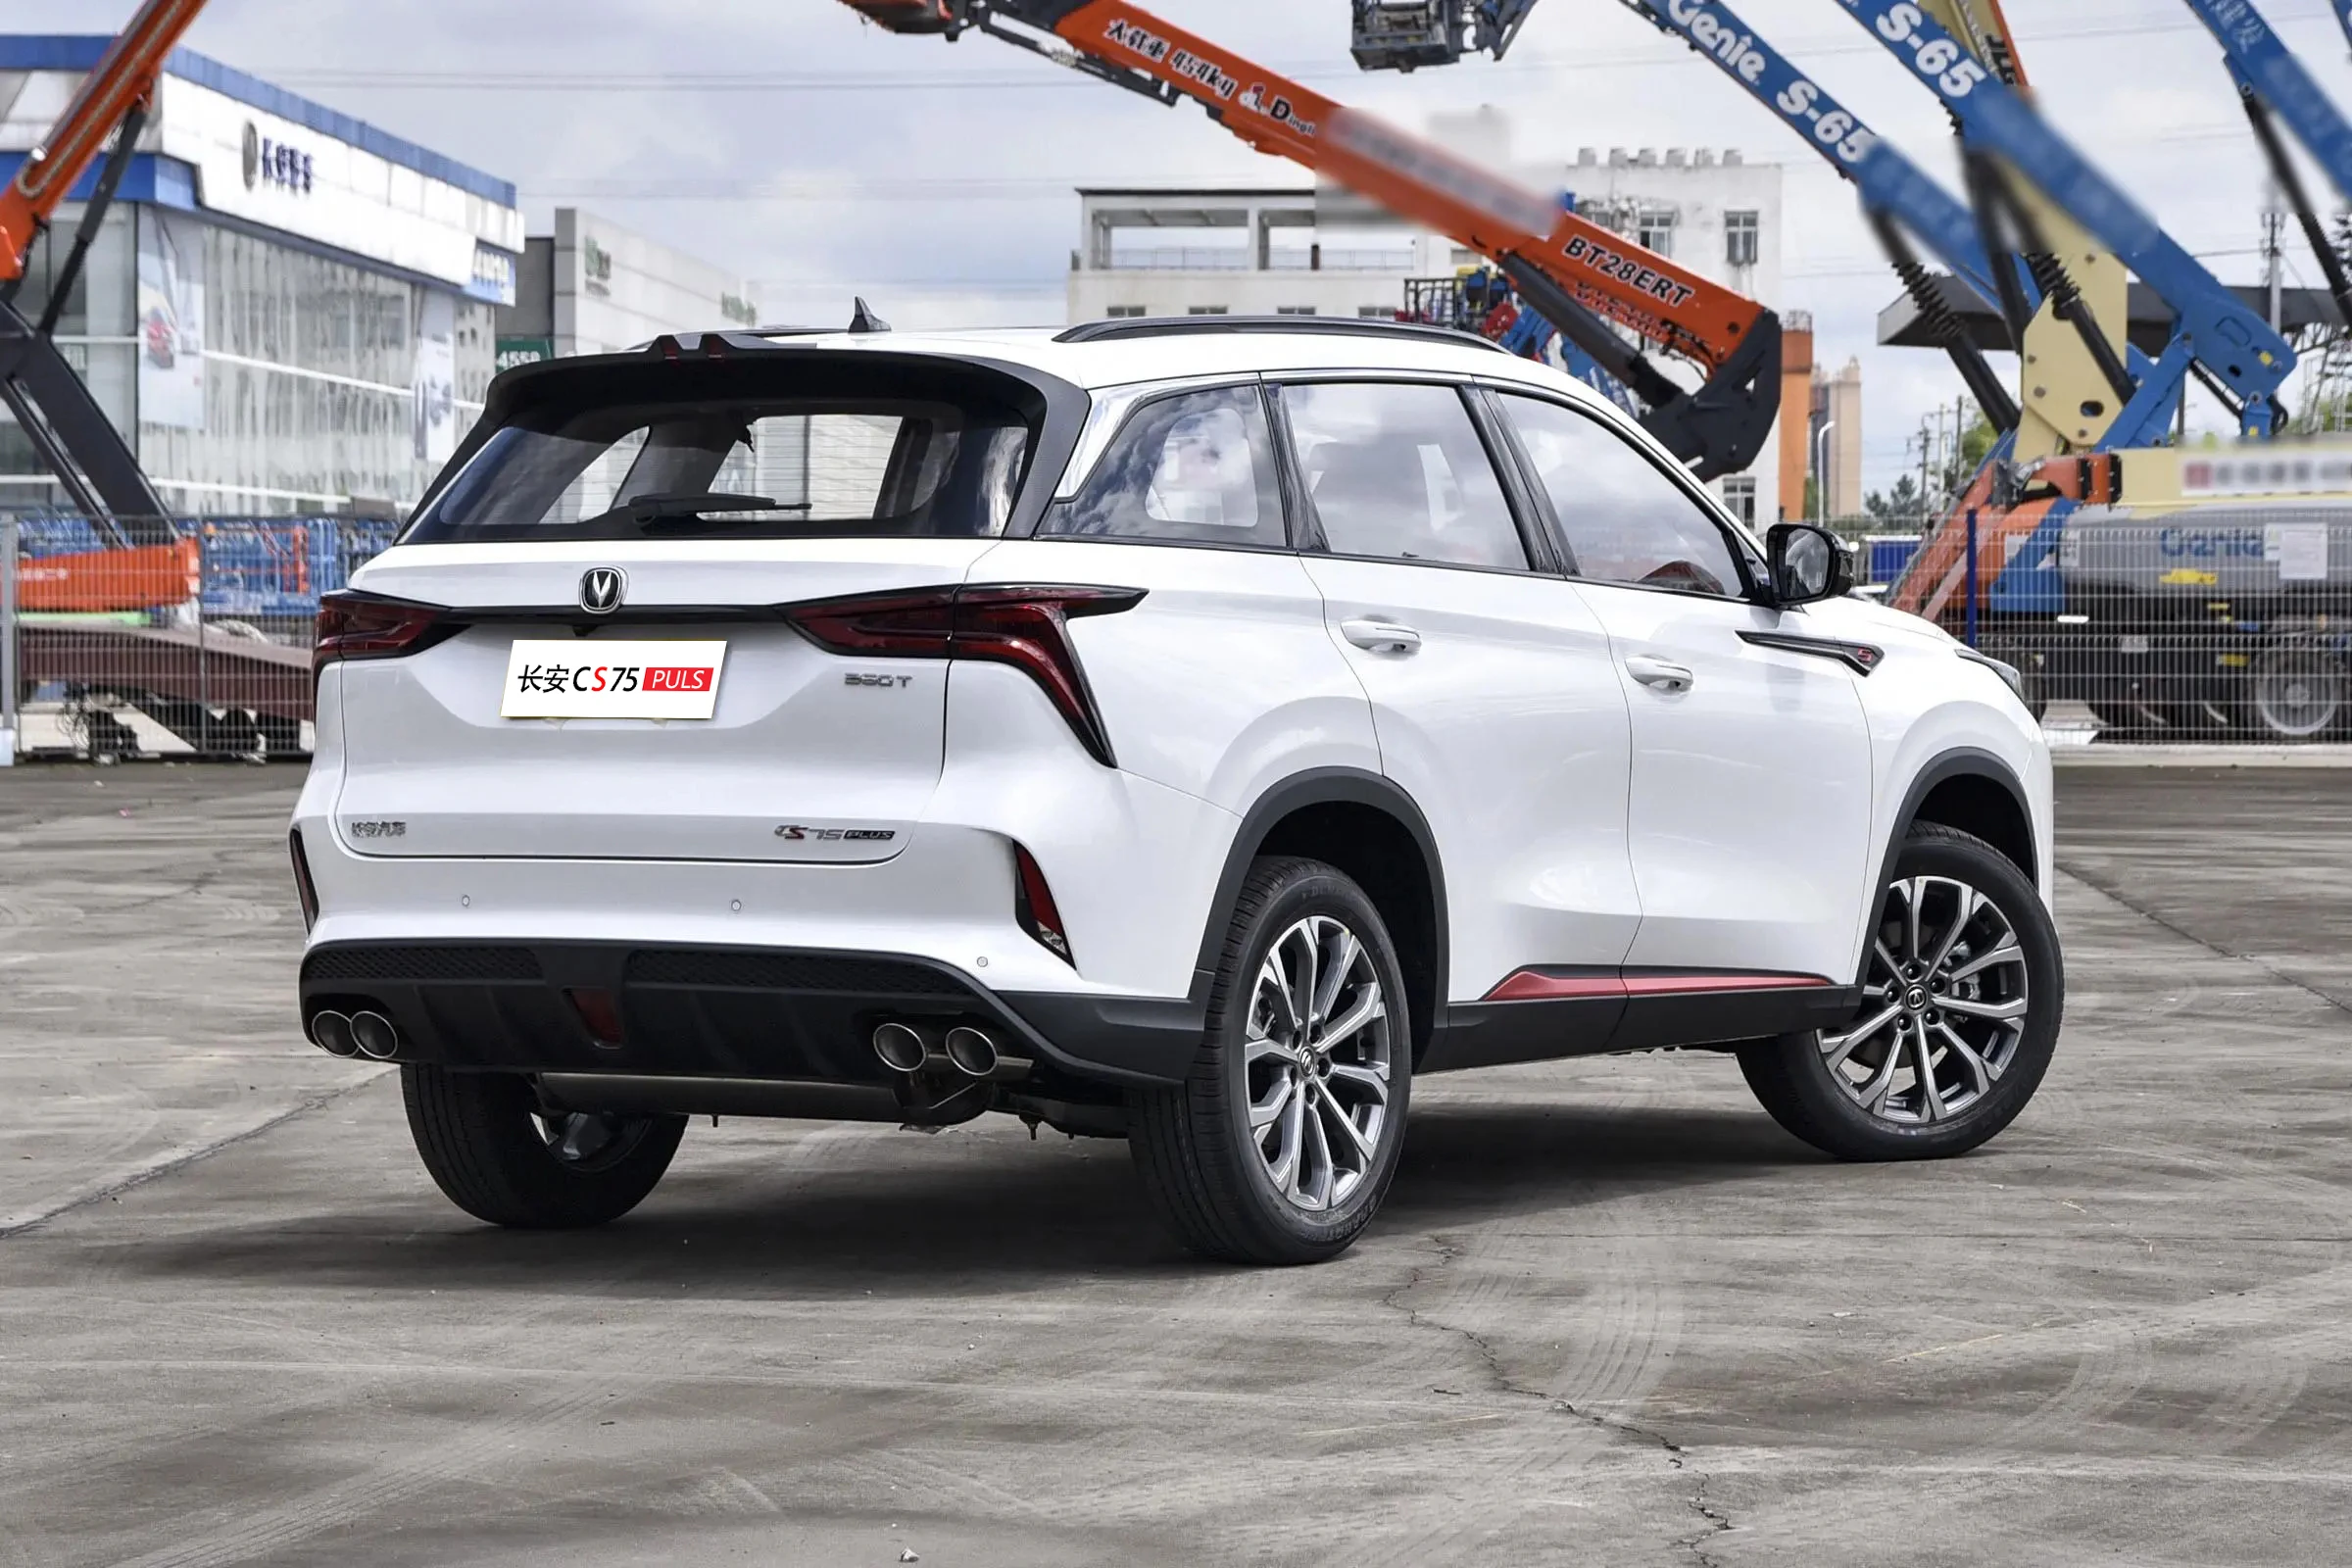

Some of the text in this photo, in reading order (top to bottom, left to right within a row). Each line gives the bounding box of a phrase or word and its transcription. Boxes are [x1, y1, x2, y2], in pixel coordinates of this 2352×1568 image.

[1876, 2, 1987, 97] S-65
[1777, 79, 1879, 163] S-65
[1562, 233, 1695, 309] BT28ERT
